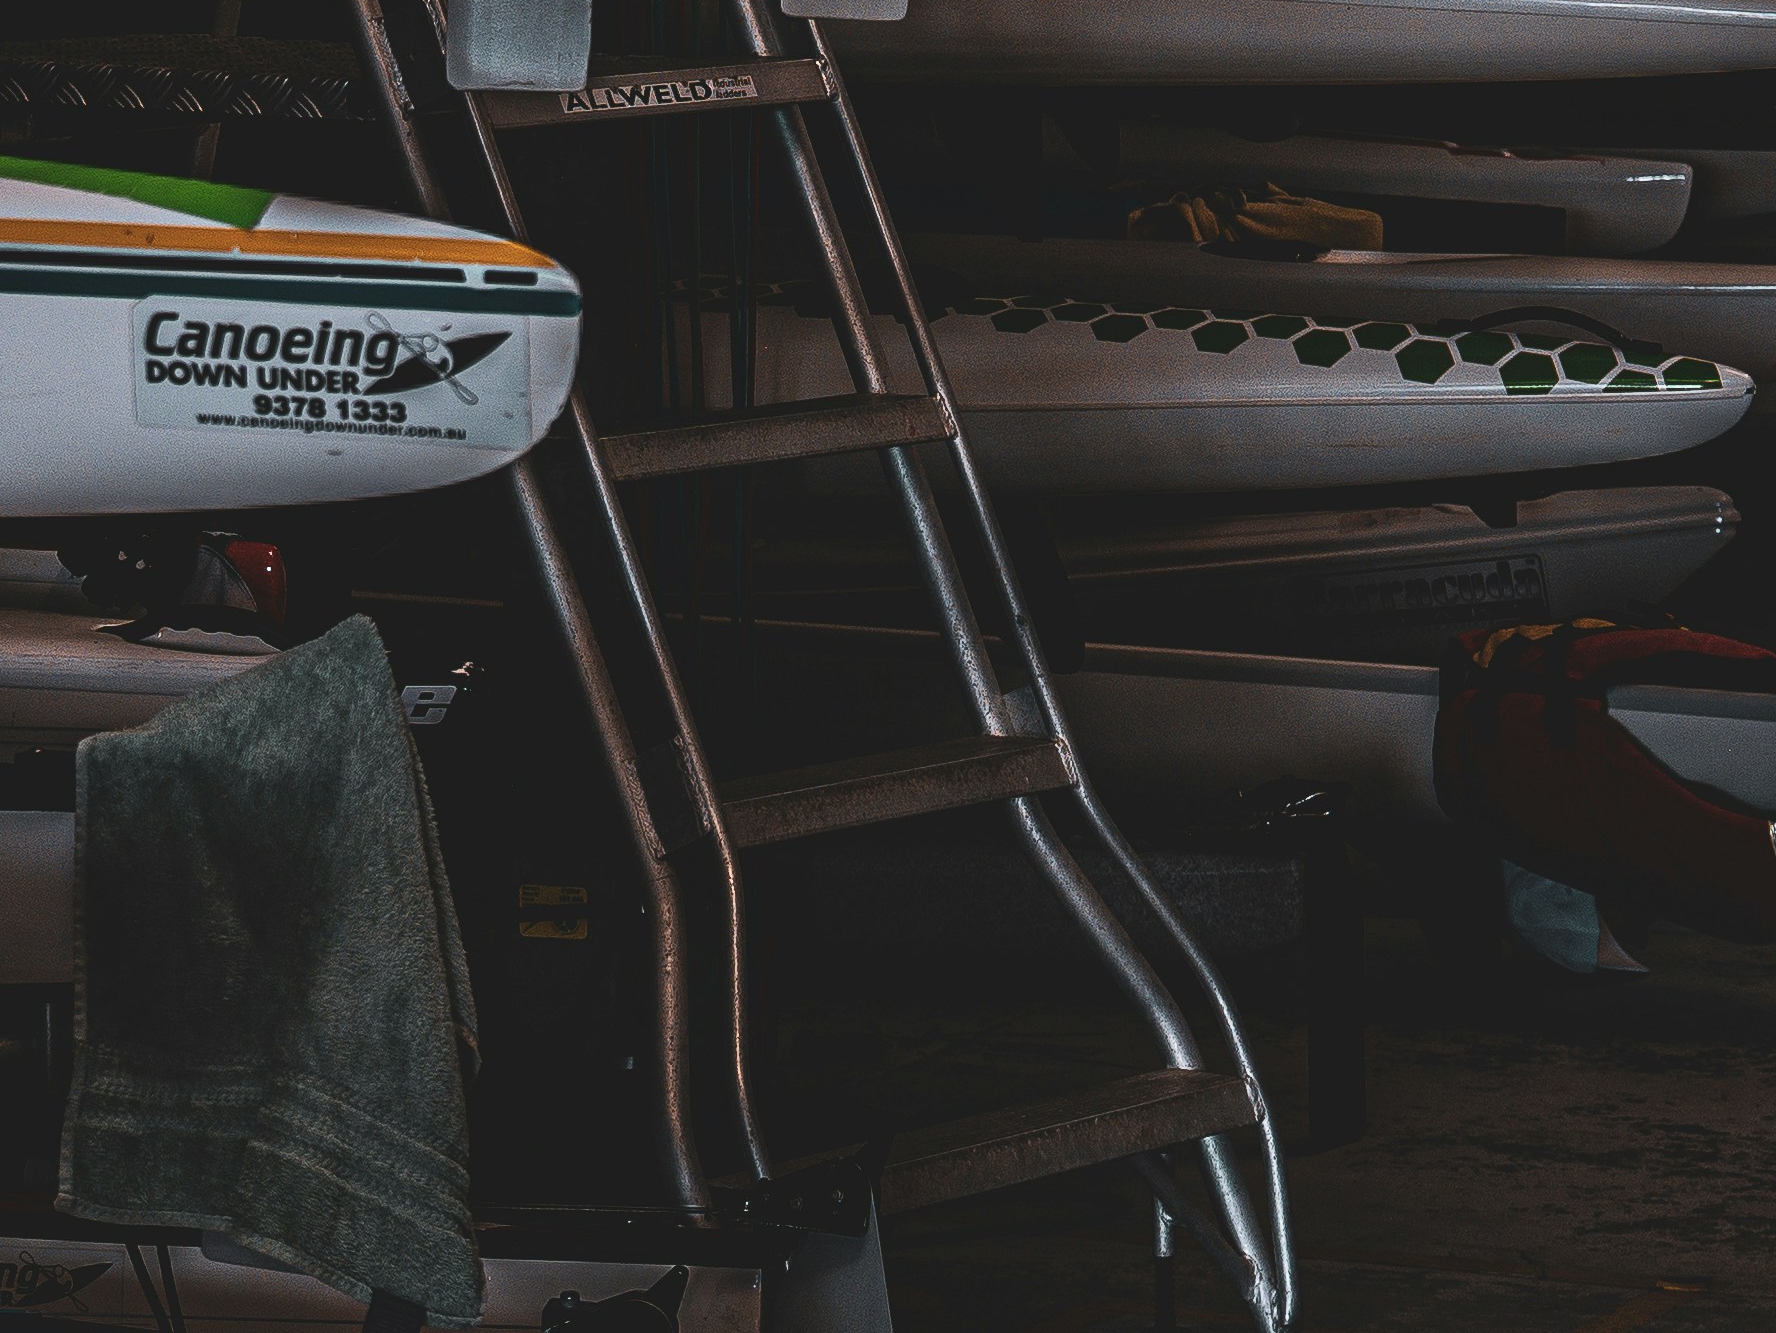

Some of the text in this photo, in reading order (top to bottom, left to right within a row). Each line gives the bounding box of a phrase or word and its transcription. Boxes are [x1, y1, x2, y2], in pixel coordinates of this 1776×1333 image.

[566, 78, 713, 112] ALLWELD
[145, 311, 400, 377] Canoeing
[145, 359, 361, 395] DOWN UNDER
[195, 411, 467, 440] www.canoeingdownunder.com.au
[252, 394, 408, 423] 9378 1333
